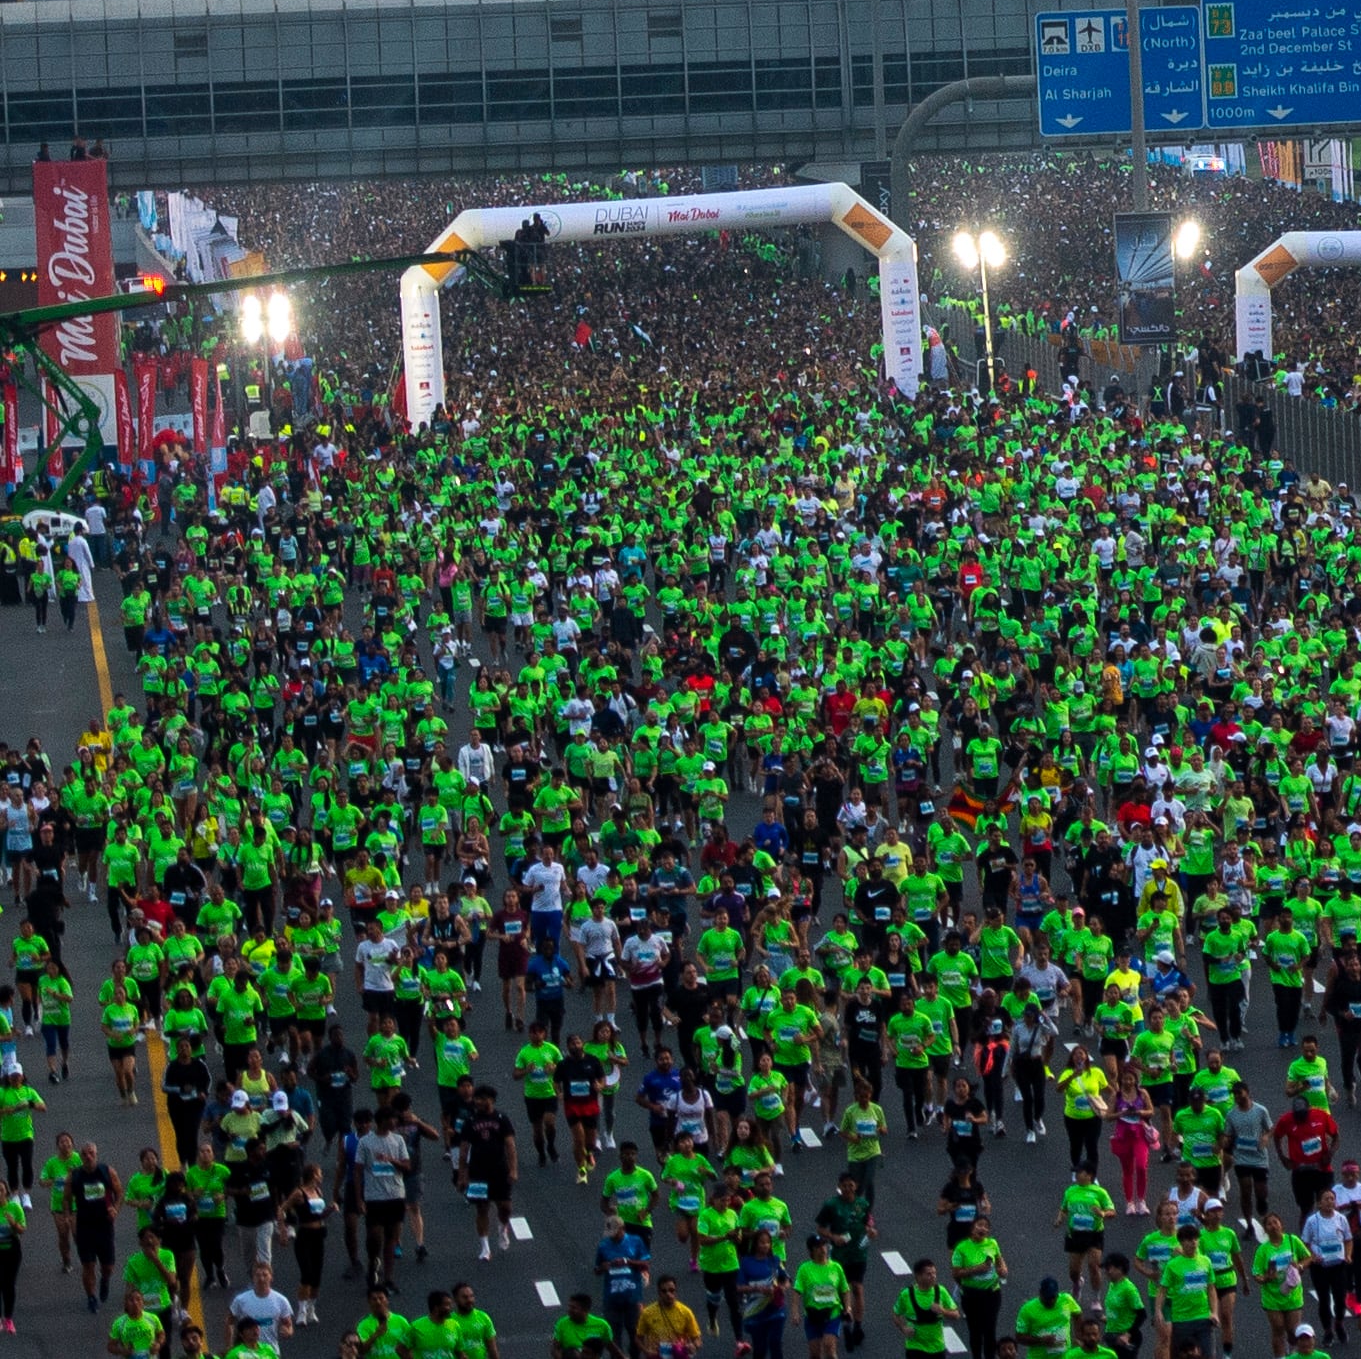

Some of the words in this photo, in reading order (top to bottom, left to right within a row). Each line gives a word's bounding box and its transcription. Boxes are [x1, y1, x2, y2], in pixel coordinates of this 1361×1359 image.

[1268, 8, 1319, 22] ديسمبر
[1325, 7, 1346, 19] من
[1142, 15, 1195, 31] (شمال)
[1212, 20, 1231, 34] 73
[1239, 27, 1296, 41] Zaa'beel
[1302, 25, 1345, 38] Palace
[1081, 44, 1100, 52] DXB
[1143, 37, 1195, 51] (North)
[1241, 44, 1264, 55] 2nd
[1269, 42, 1332, 54] December
[1338, 40, 1352, 51] St
[1043, 65, 1077, 77] Deira
[1168, 59, 1198, 71] ديرة
[1242, 62, 1270, 76] زايد
[1276, 64, 1293, 76] بن
[1301, 59, 1344, 75] خليفة
[1045, 90, 1057, 100] Al
[1063, 88, 1112, 102] Sharjah
[1145, 80, 1199, 96] الشارقة
[1243, 86, 1285, 97] Sheikh
[1290, 82, 1334, 95] Khalifa
[1339, 81, 1359, 92] Bin
[1210, 107, 1255, 119] 1000m
[595, 205, 648, 223] DUBAI
[667, 210, 690, 222] Mai
[691, 207, 720, 221] Dubai
[594, 221, 625, 235] RUN
[48, 184, 96, 288] Dubai
